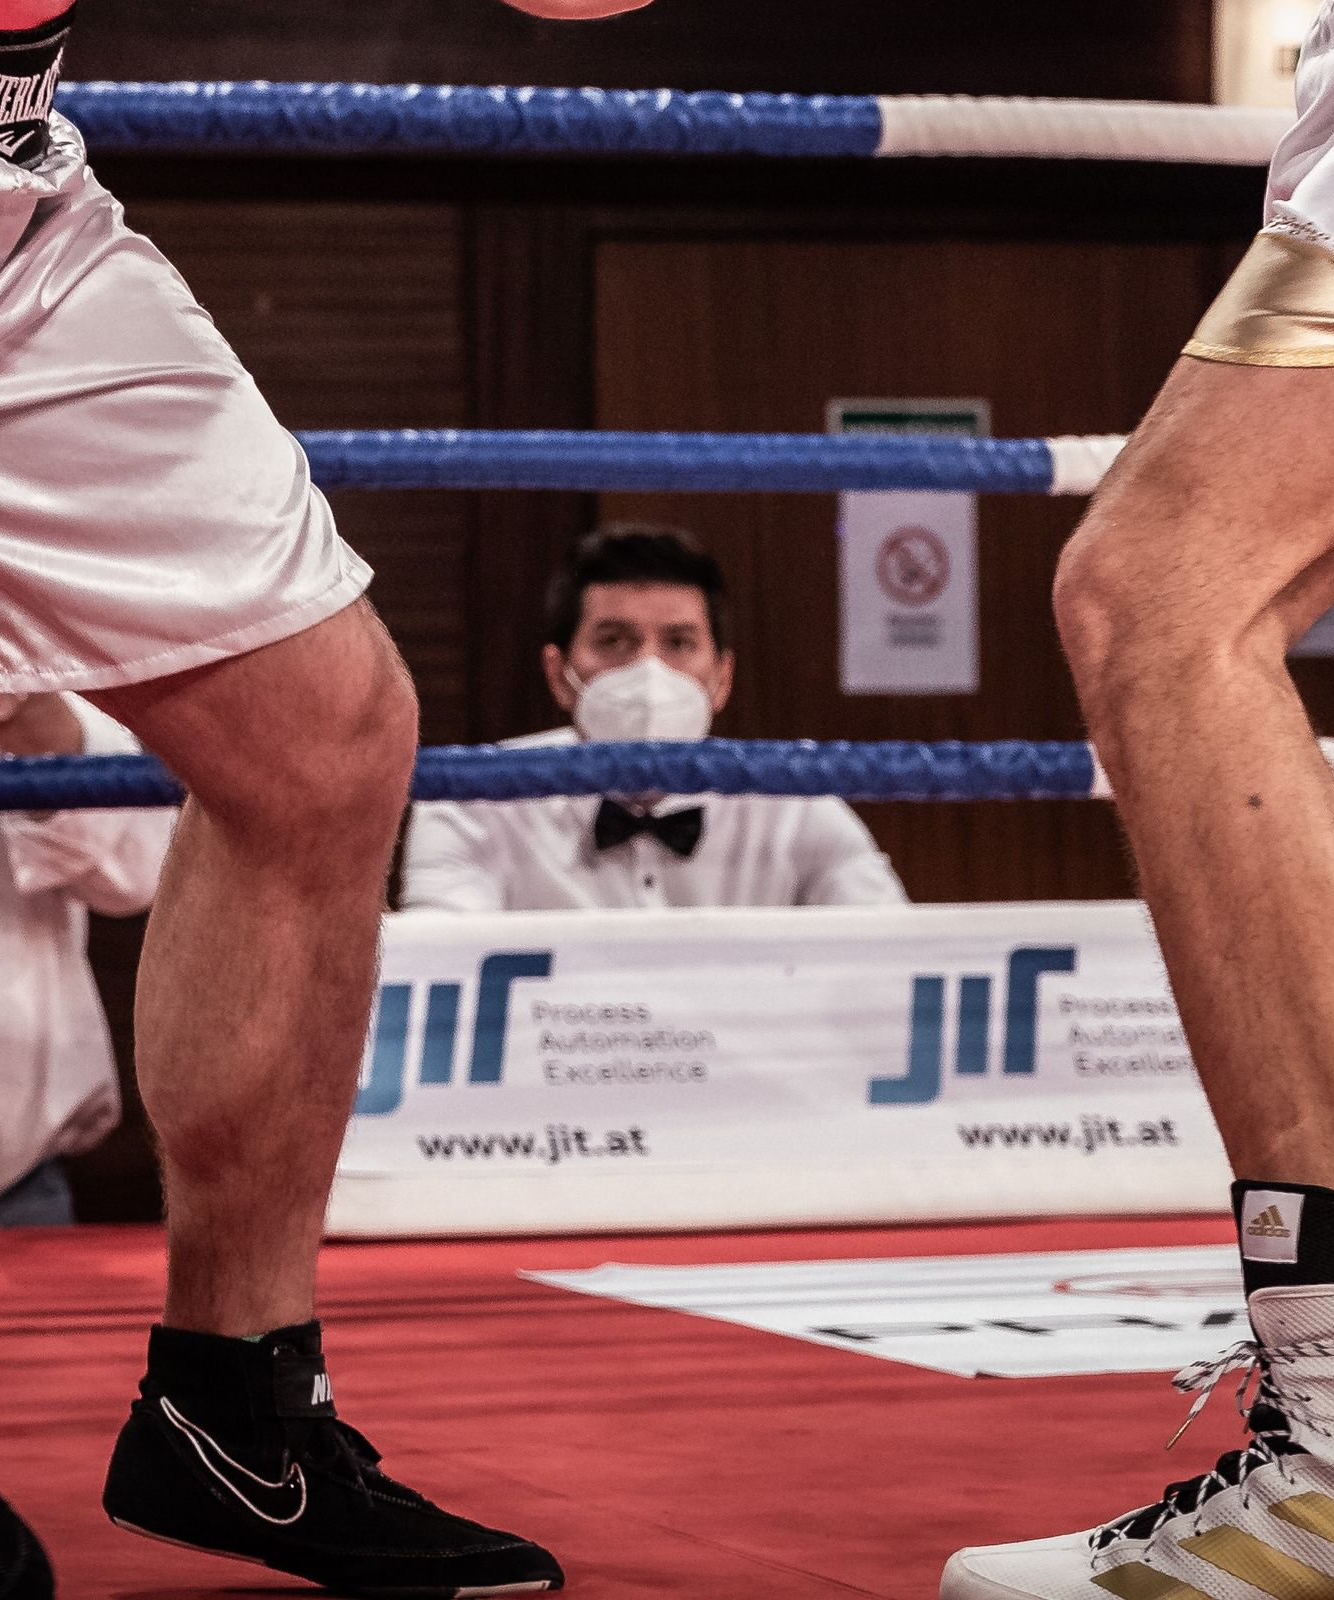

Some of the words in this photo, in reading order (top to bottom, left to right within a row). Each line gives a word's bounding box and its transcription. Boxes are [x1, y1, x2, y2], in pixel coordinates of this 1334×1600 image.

[531, 1000, 652, 1025] Process
[539, 1027, 716, 1055] Automation
[543, 1058, 709, 1086] Excellence
[416, 1124, 648, 1164] www.jit.at
[957, 1114, 1181, 1155] www.jit.at
